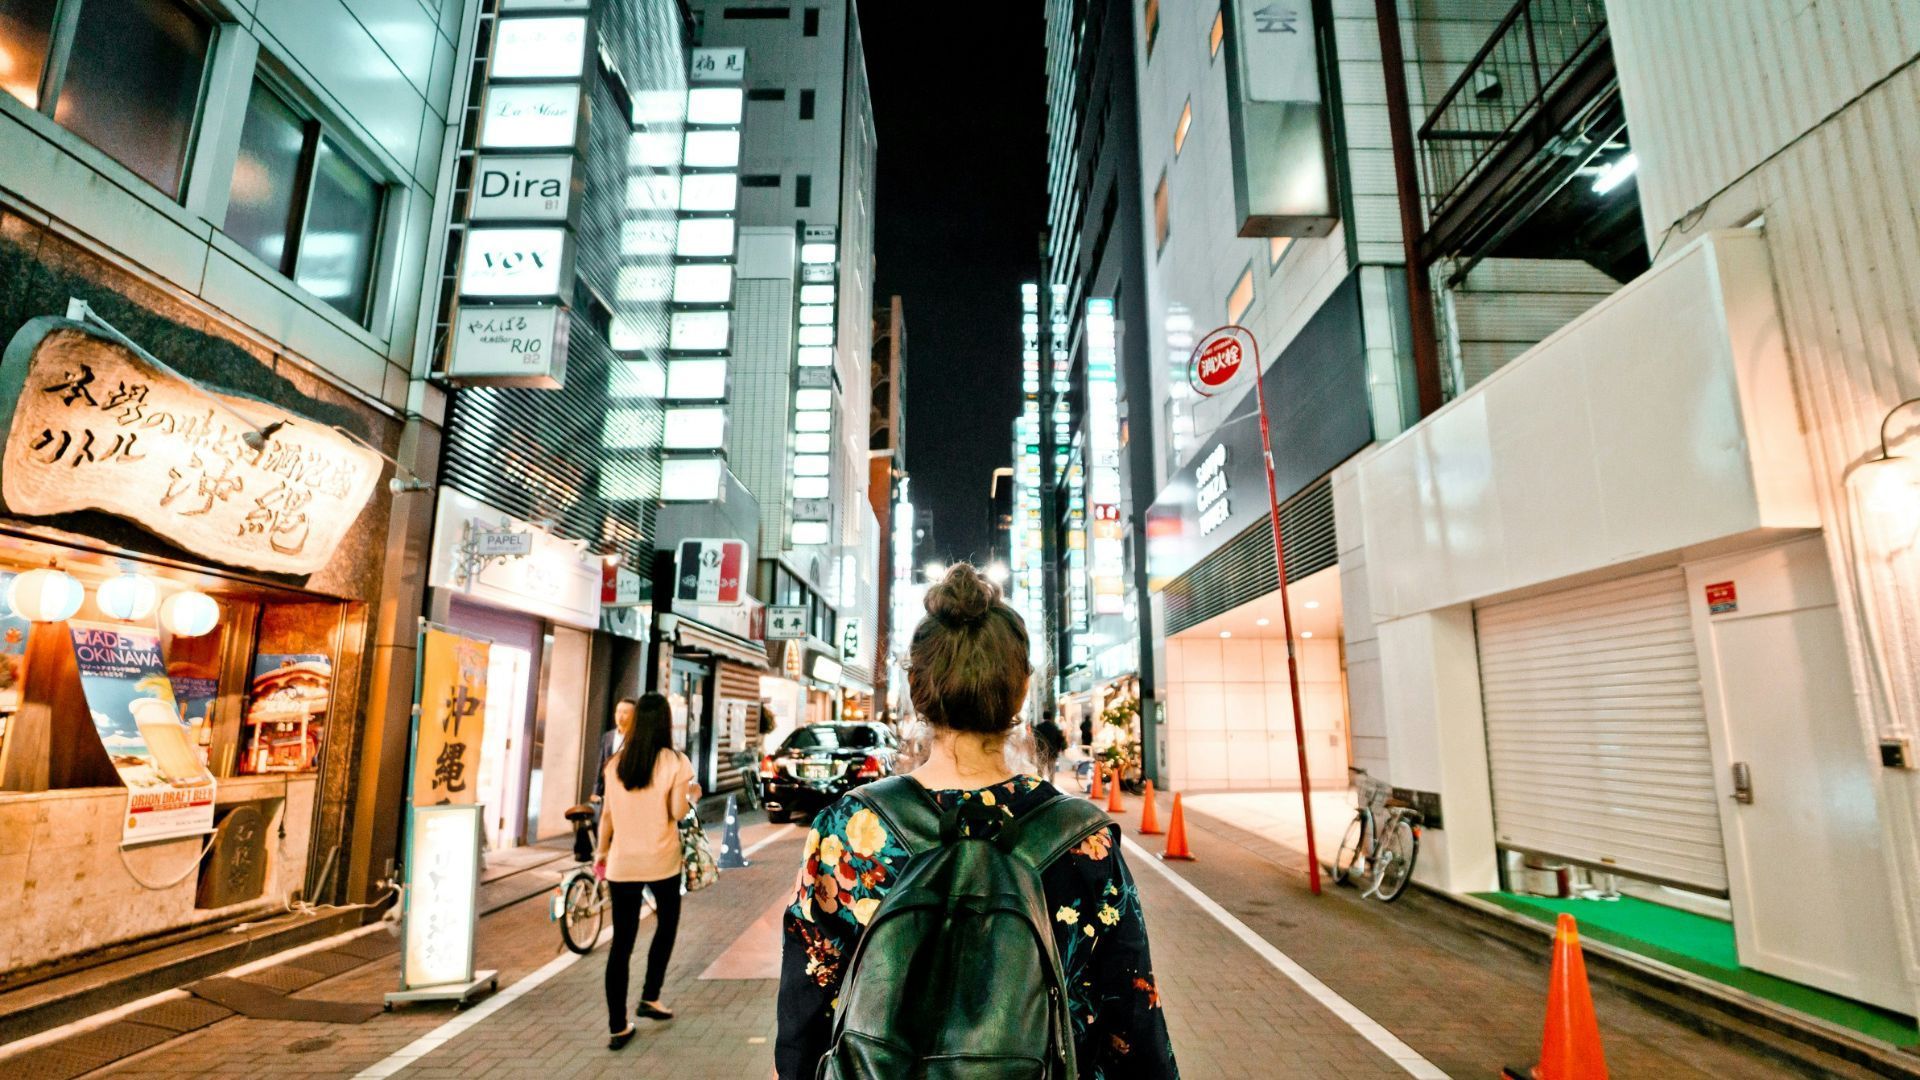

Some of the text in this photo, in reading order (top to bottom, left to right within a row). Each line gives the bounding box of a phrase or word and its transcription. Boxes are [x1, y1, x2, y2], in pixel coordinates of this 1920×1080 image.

[480, 171, 561, 198] Dira
[544, 200, 559, 211] B1
[467, 316, 528, 334] やんばる
[510, 338, 542, 354] RIO
[523, 353, 541, 364] B2
[1201, 345, 1240, 378] 消火栓
[487, 535, 523, 545] PAPEL
[76, 630, 130, 650] MADE
[77, 646, 163, 667] OKINAWA
[432, 685, 481, 805] 沖縄
[131, 794, 160, 807] ORION
[162, 789, 192, 803] DRAFT
